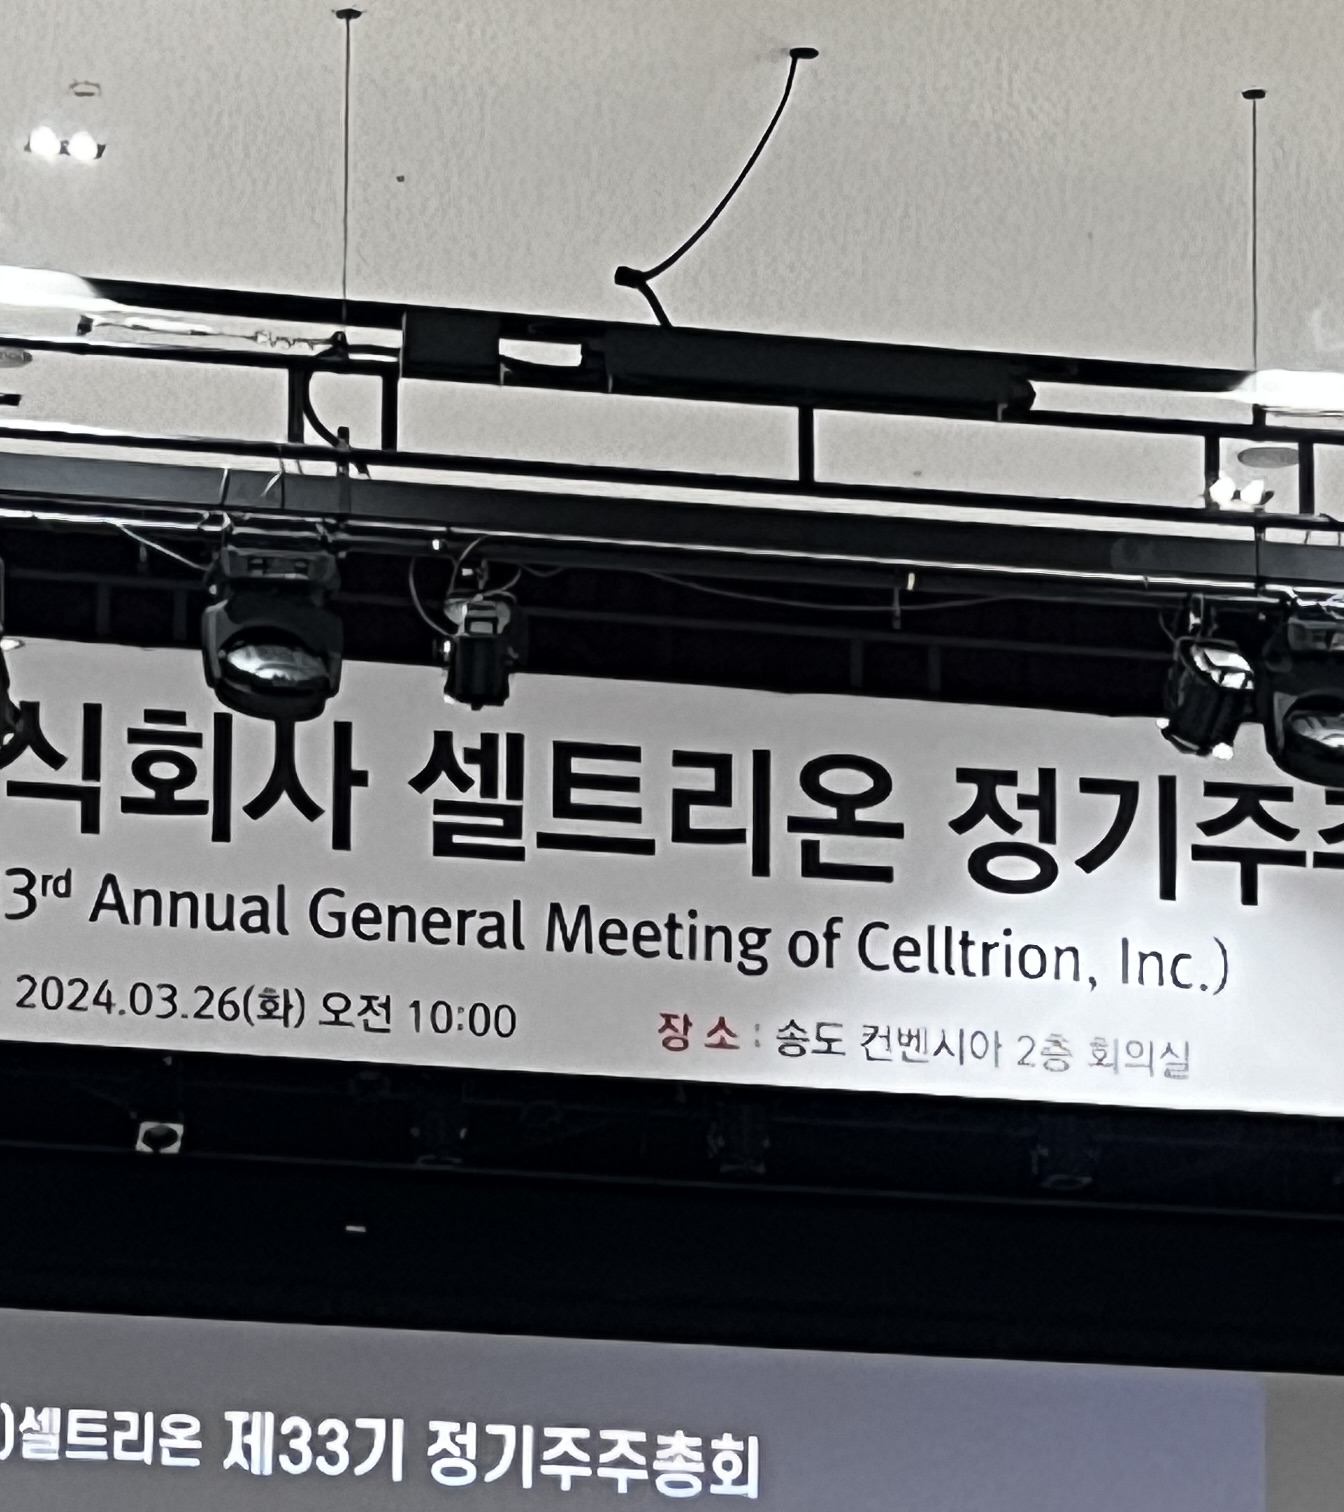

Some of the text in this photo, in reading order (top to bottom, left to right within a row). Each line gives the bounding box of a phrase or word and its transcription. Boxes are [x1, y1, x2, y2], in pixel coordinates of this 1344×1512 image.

[407, 728, 905, 884] 셀트리온
[88, 872, 290, 936] Annual
[308, 887, 526, 952] General
[545, 902, 773, 977] Meeting
[787, 916, 844, 969] of
[857, 920, 1097, 991] Celltrion,
[1121, 936, 1229, 996] Inc.)
[15, 973, 306, 1030] 2024.03.26(화)
[318, 991, 393, 1034] 오전
[408, 999, 517, 1039] 10:00
[775, 1018, 847, 1058] 송도
[860, 1024, 1003, 1068] 컨벤시아
[1017, 1033, 1073, 1073] 2층
[1088, 1036, 1190, 1080] 회의실
[222, 1410, 405, 1483] 제33기
[427, 1420, 760, 1499] 정기주주총회
